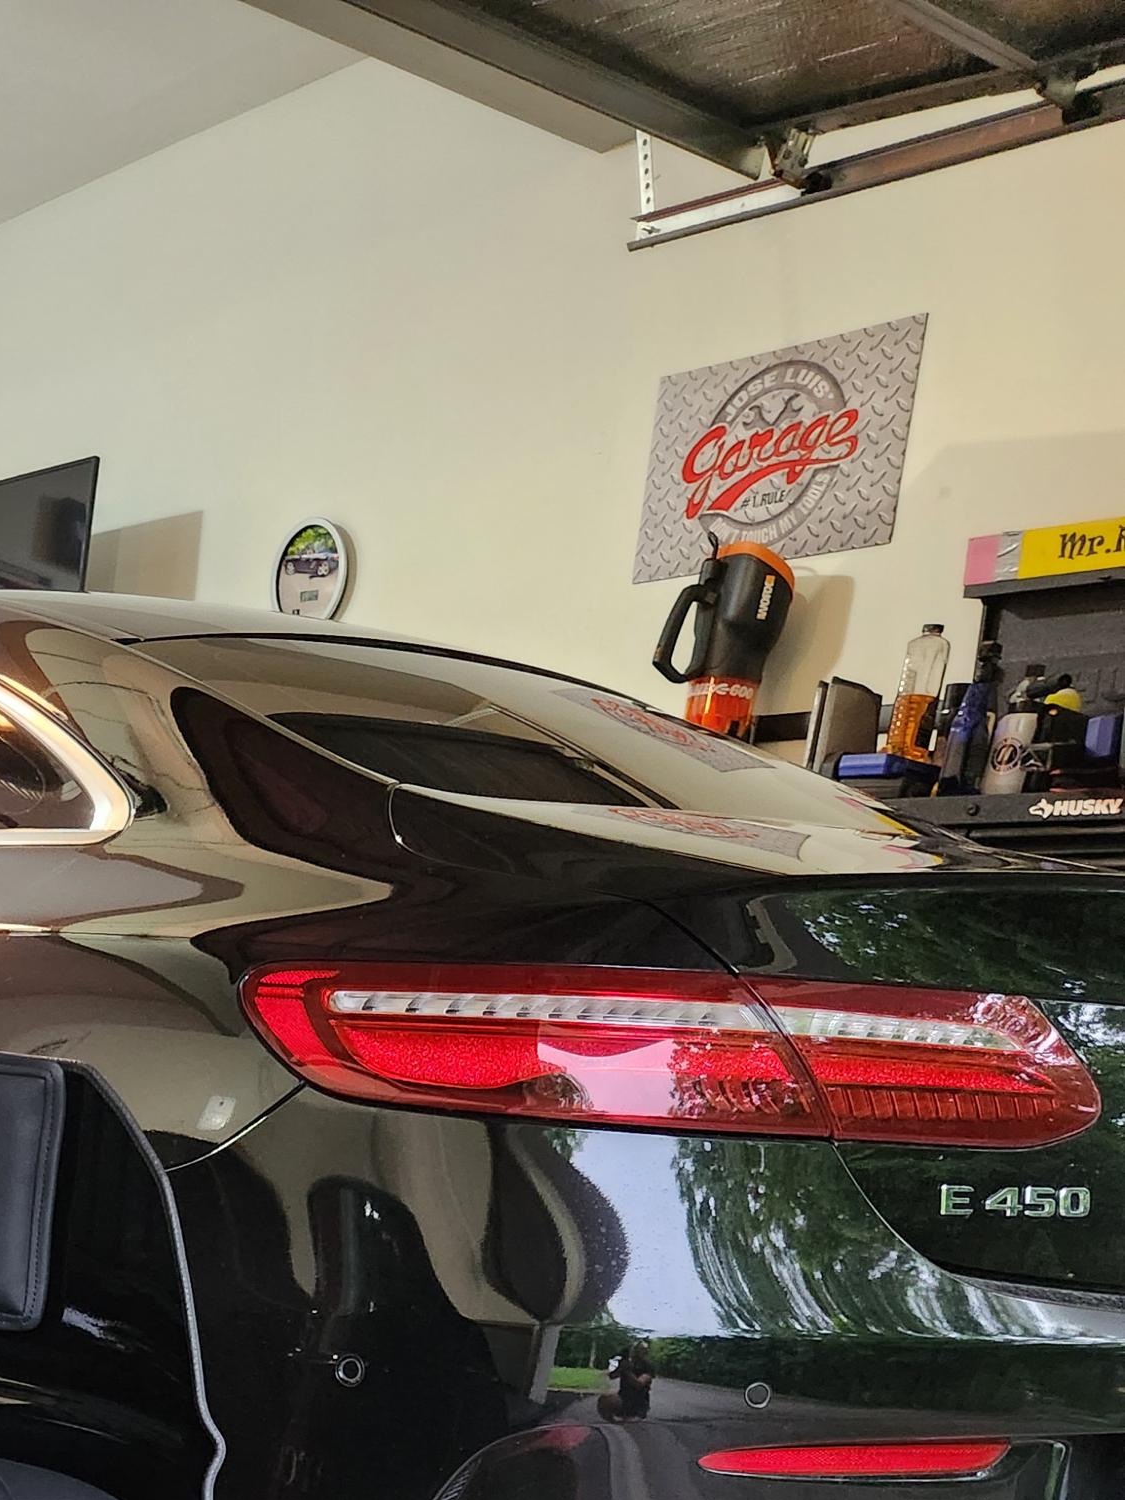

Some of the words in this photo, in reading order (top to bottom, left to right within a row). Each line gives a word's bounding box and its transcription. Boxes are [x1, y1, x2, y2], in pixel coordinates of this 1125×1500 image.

[726, 372, 779, 422] JOSE
[682, 408, 859, 520] Garage
[778, 511, 797, 534] MY
[797, 472, 832, 515] TOOLS
[1052, 798, 1124, 816] HUSKY
[939, 1184, 975, 1216] E
[984, 1185, 1091, 1217] 450
